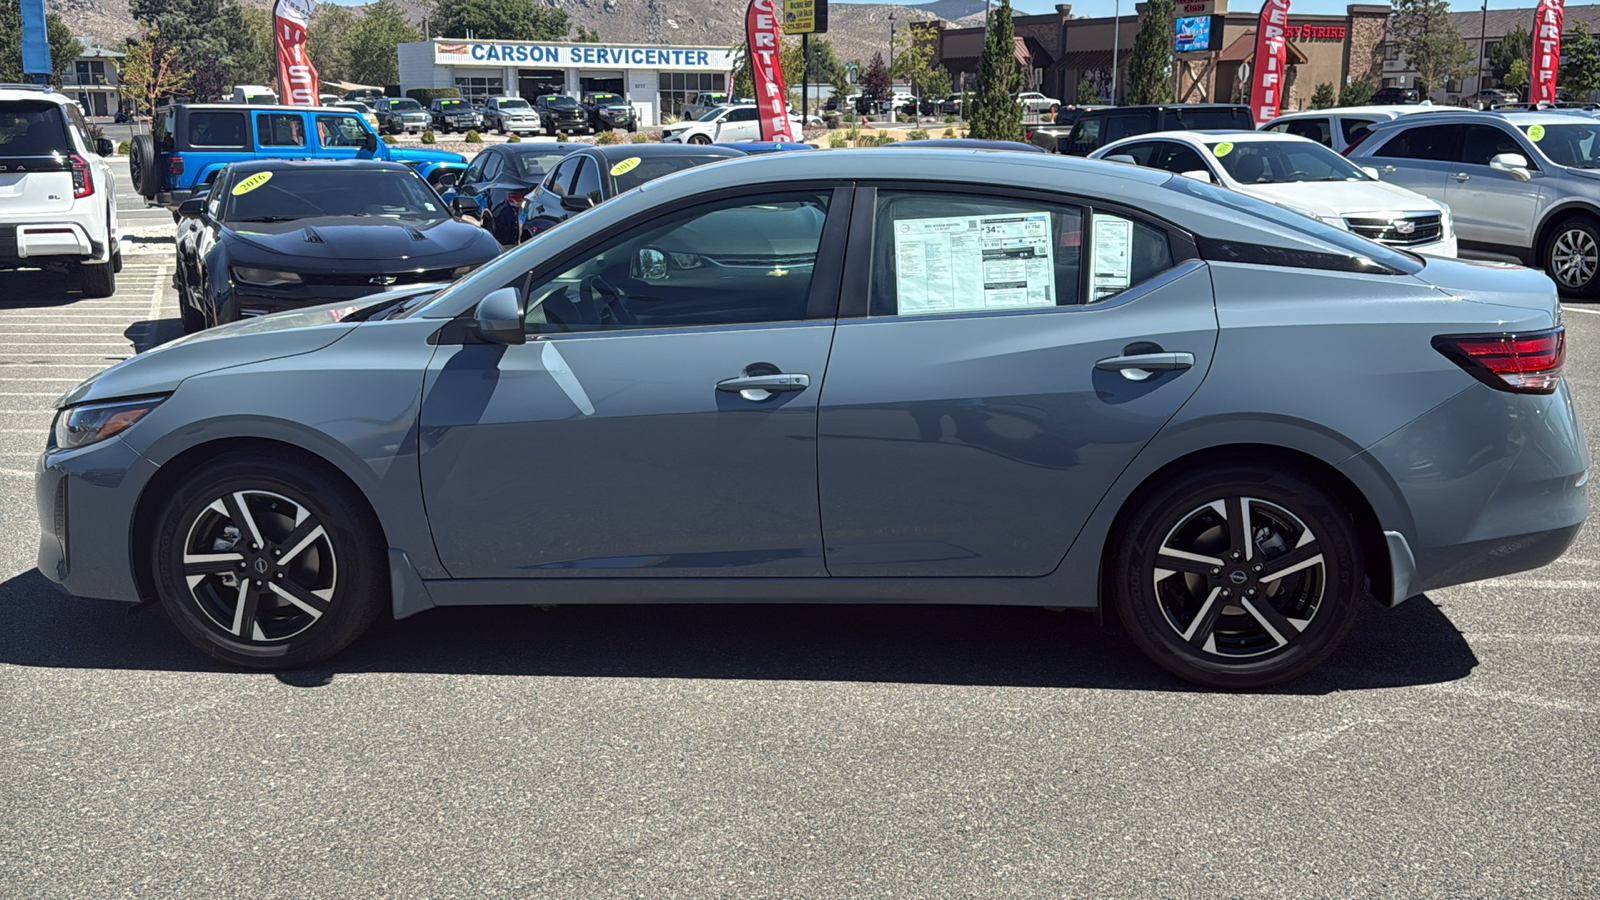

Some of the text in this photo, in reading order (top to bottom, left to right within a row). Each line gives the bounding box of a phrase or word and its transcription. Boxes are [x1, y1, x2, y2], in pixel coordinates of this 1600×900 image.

[1284, 24, 1346, 38] KY STRIKE
[471, 43, 559, 63] CARSON
[570, 46, 709, 66] SERVICENTER
[1538, 0, 1561, 105] CERTIFI
[615, 159, 634, 173] 2017
[239, 174, 266, 191] 2016
[985, 226, 996, 234] 34
